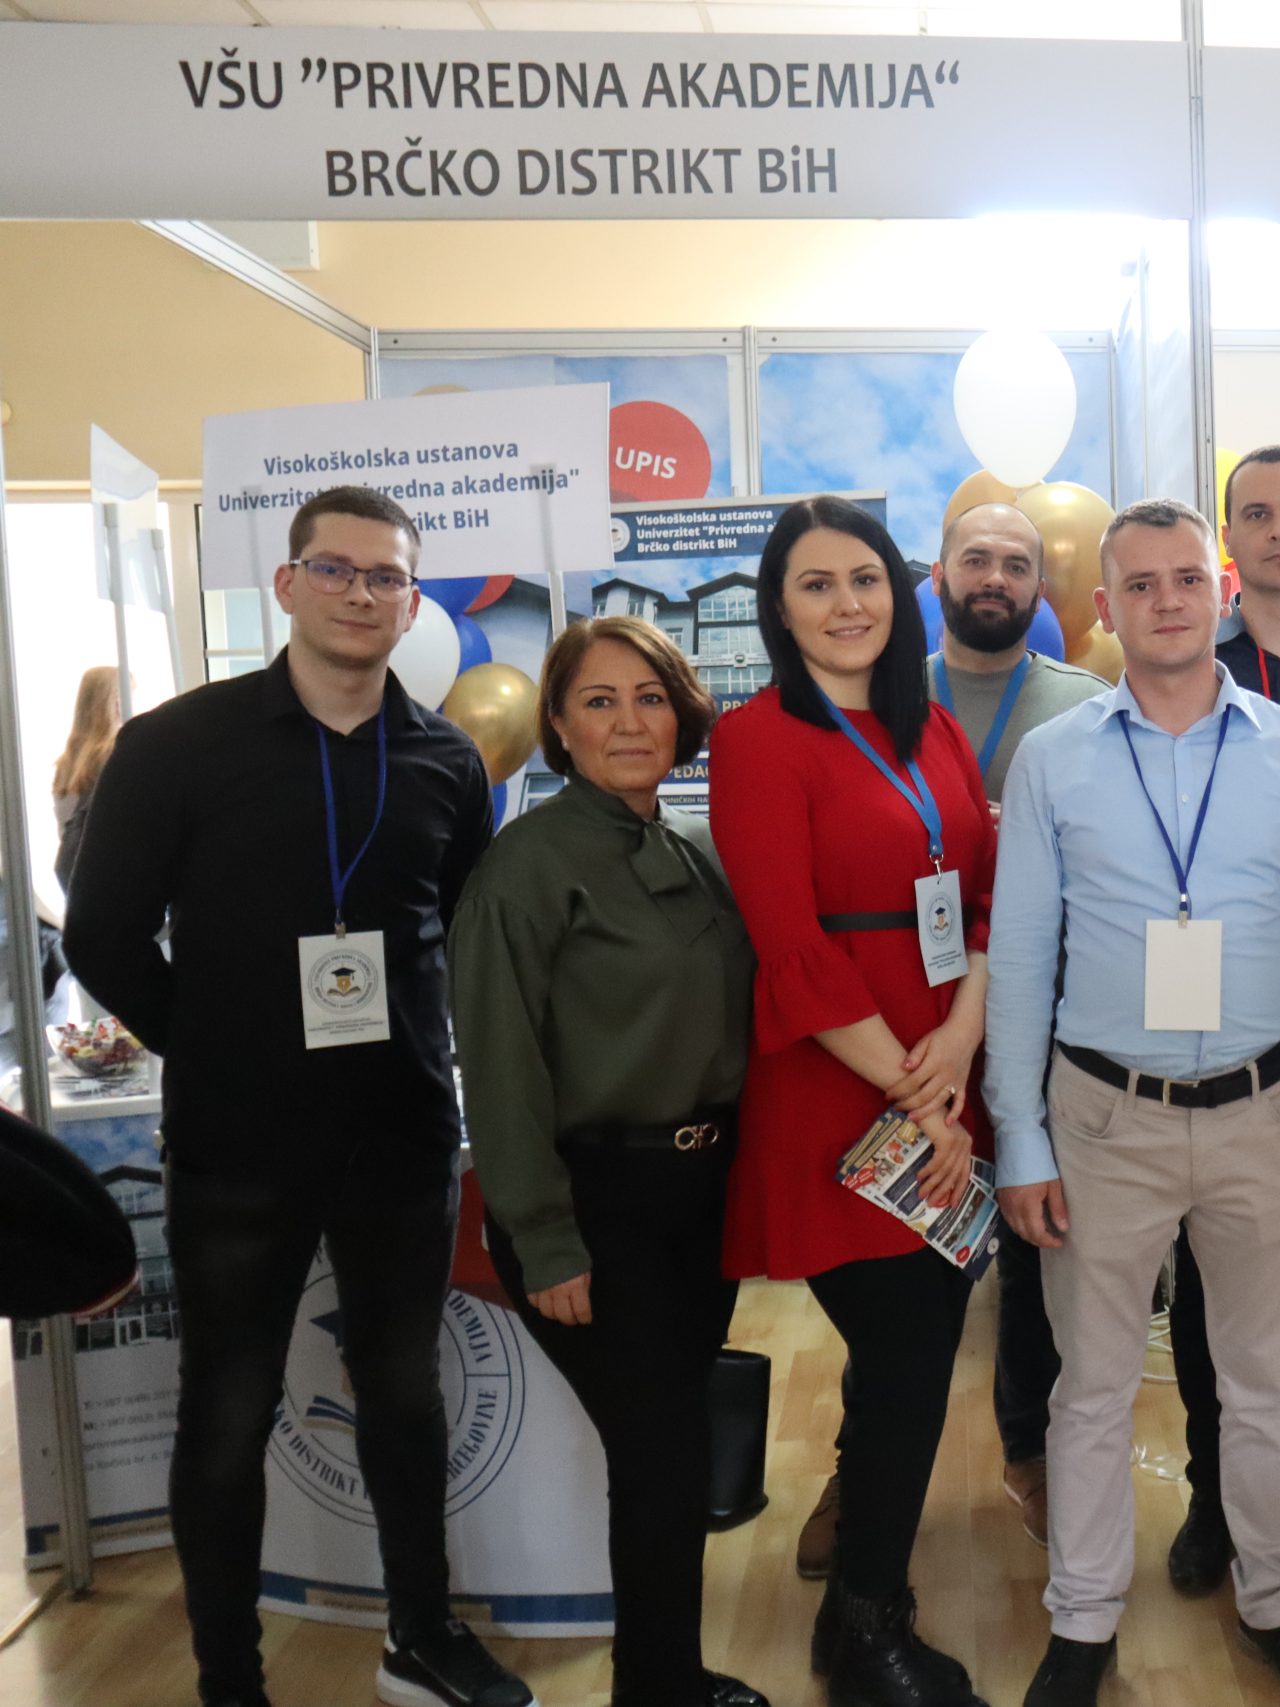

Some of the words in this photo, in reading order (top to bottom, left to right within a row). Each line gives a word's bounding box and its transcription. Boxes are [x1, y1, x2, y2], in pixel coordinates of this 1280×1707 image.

[178, 47, 283, 110] VŠU
[325, 136, 500, 197] BRČKO
[517, 148, 742, 196] DISTRIKT
[759, 145, 839, 194] BiH
[263, 447, 410, 476] Visokoškolska
[416, 443, 519, 466] ustanova
[615, 446, 678, 479] UPIS
[452, 468, 580, 498] akademija"
[453, 508, 490, 529] BiH
[636, 511, 716, 526] Visokoškolska
[719, 510, 773, 522] ustanova
[636, 526, 700, 539] Univerzitet
[702, 523, 765, 536] "Privredna
[637, 540, 670, 553] Brčko
[672, 539, 715, 552] distrikt
[717, 538, 737, 549] BiH
[447, 1289, 493, 1363] DEMIJA
